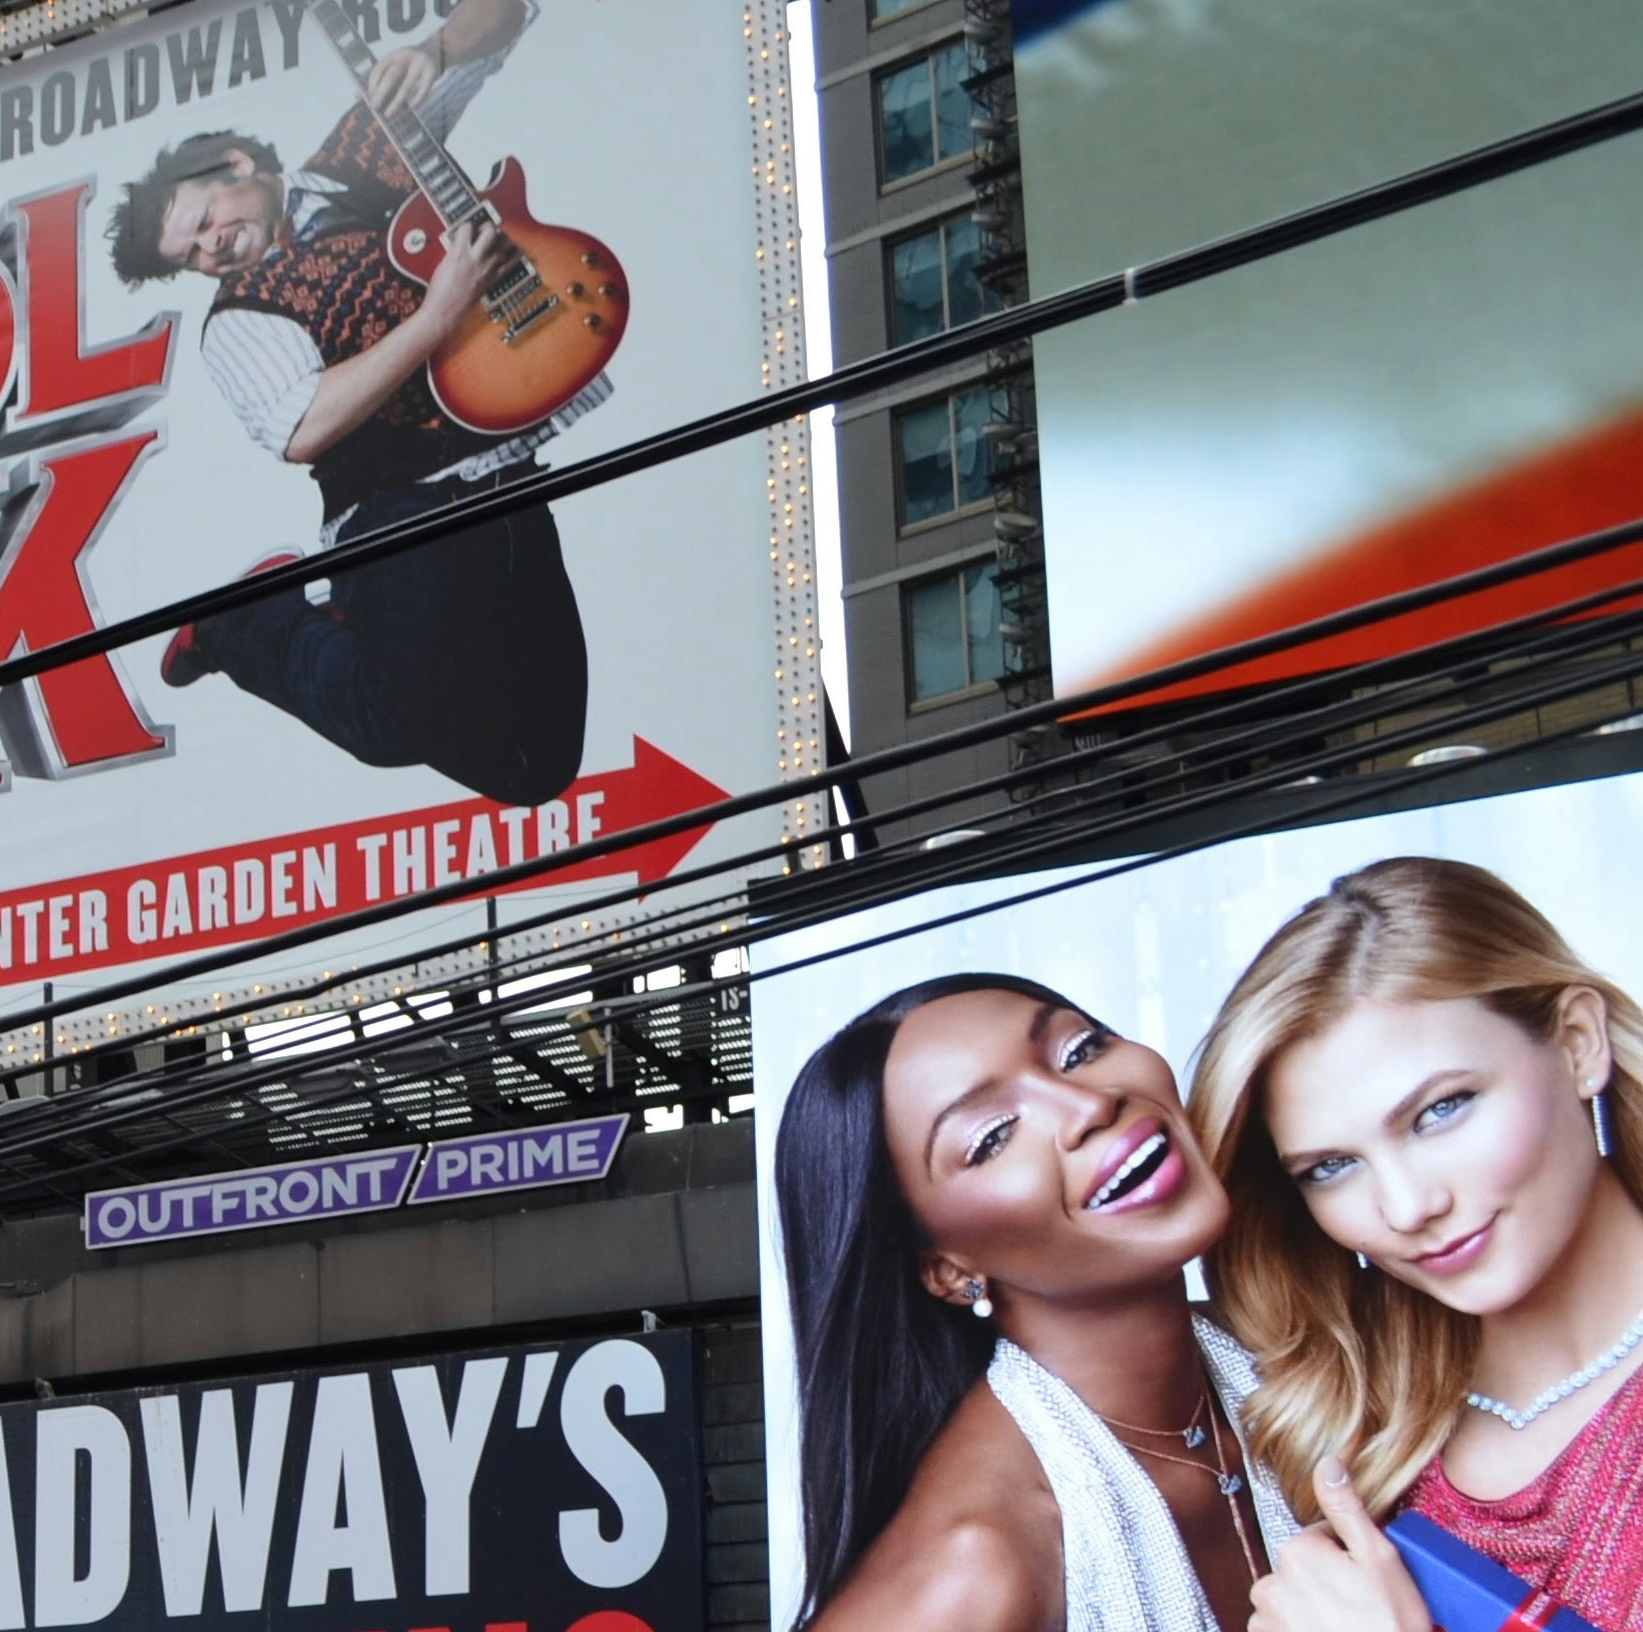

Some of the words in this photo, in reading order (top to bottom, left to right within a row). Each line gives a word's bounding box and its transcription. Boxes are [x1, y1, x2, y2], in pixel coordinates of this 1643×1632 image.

[127, 842, 337, 944] GARDEN
[356, 791, 606, 901] THEATRE
[96, 1151, 403, 1236] OUTFRONT
[436, 1128, 601, 1190] PRIME
